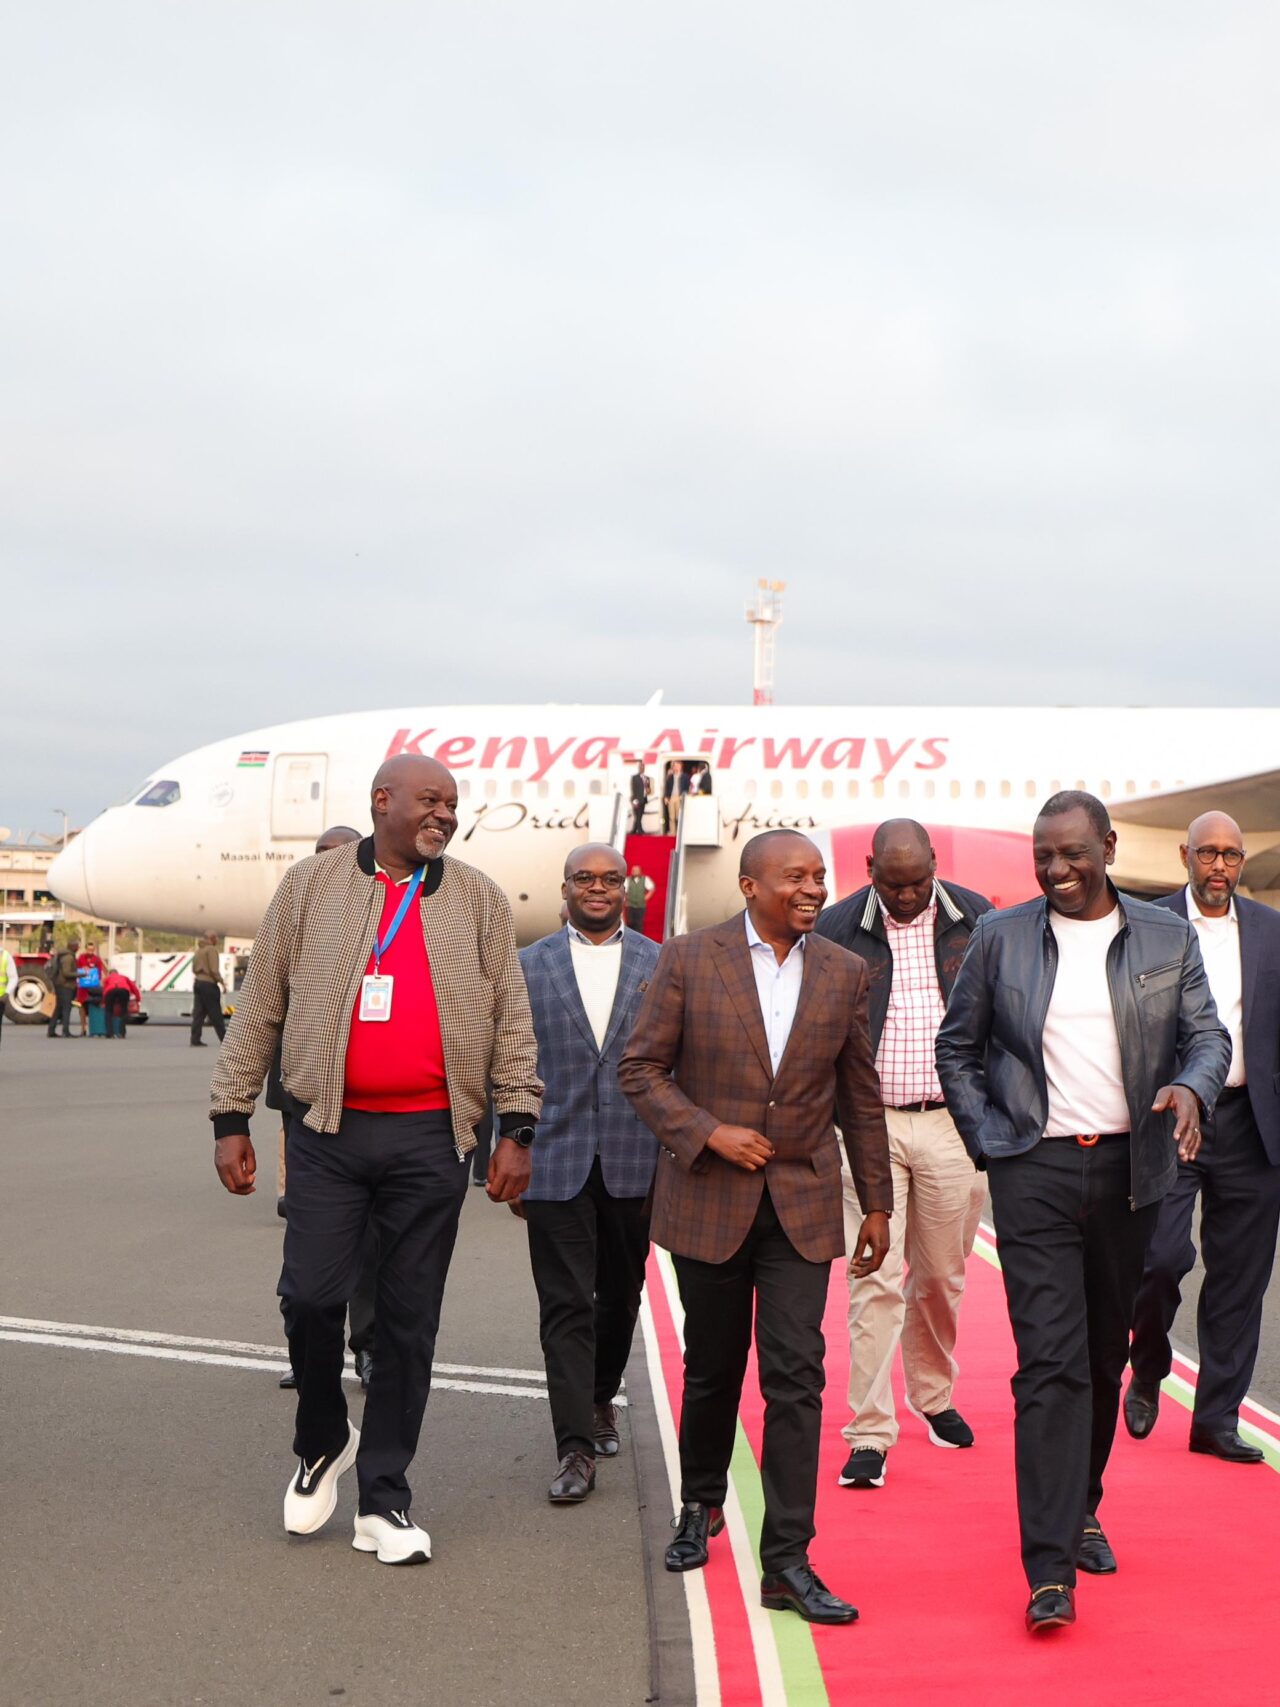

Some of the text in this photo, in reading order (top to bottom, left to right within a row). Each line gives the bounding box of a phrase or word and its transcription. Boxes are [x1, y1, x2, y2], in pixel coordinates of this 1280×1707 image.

[382, 728, 949, 783] Kenya Airways
[463, 802, 590, 842] Prid
[265, 851, 294, 861] Mara
